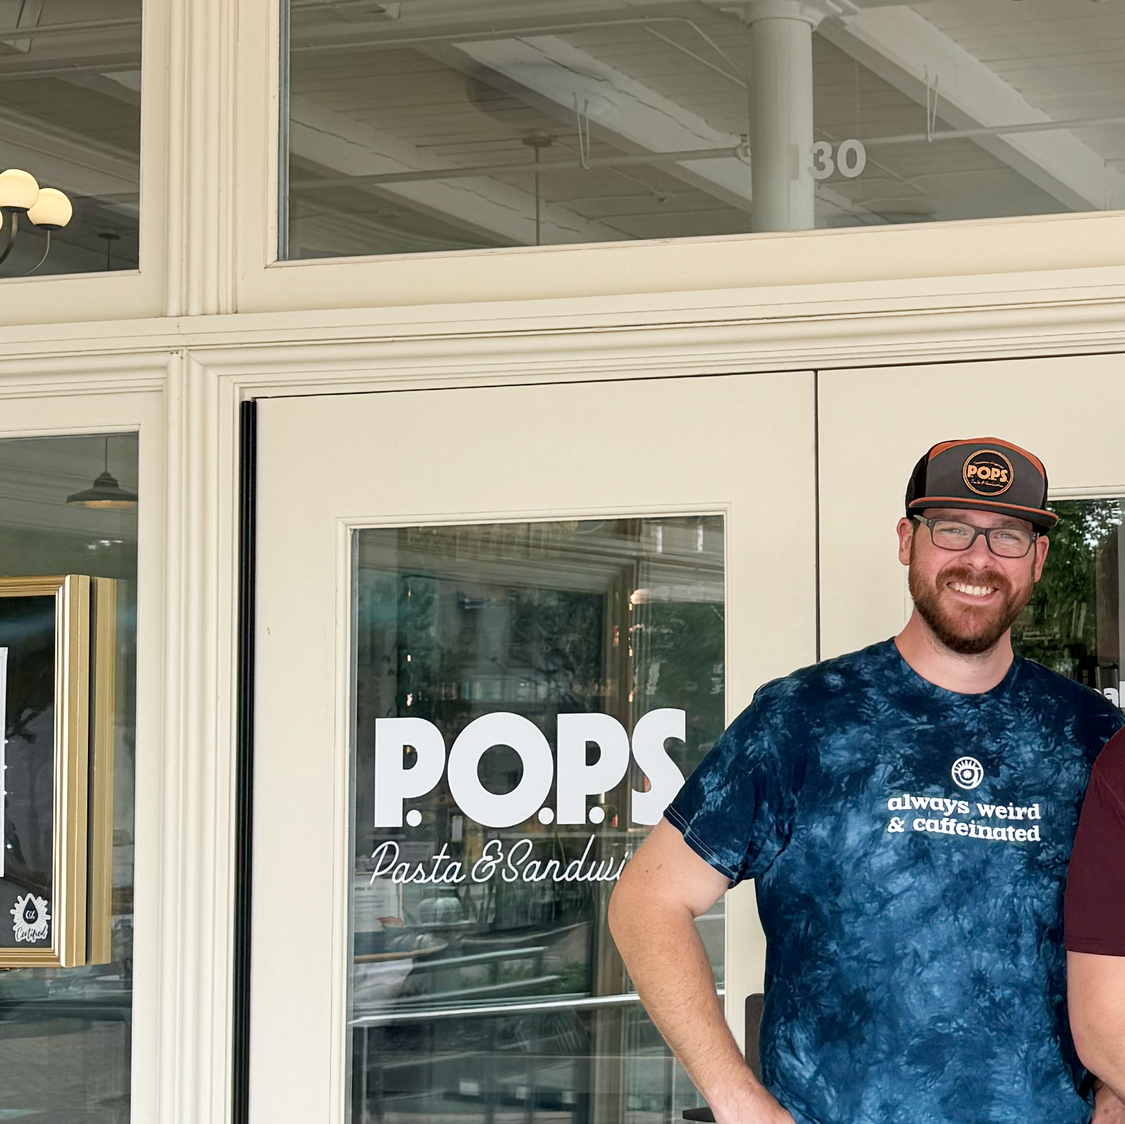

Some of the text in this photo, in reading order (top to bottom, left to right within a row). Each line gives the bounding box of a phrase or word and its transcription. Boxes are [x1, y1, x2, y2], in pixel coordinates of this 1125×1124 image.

[887, 794, 1041, 820] always weird
[887, 817, 1041, 841] & caffeinated
[370, 841, 466, 884] Pasta
[471, 839, 503, 884] &
[502, 833, 630, 883] Sandwi
